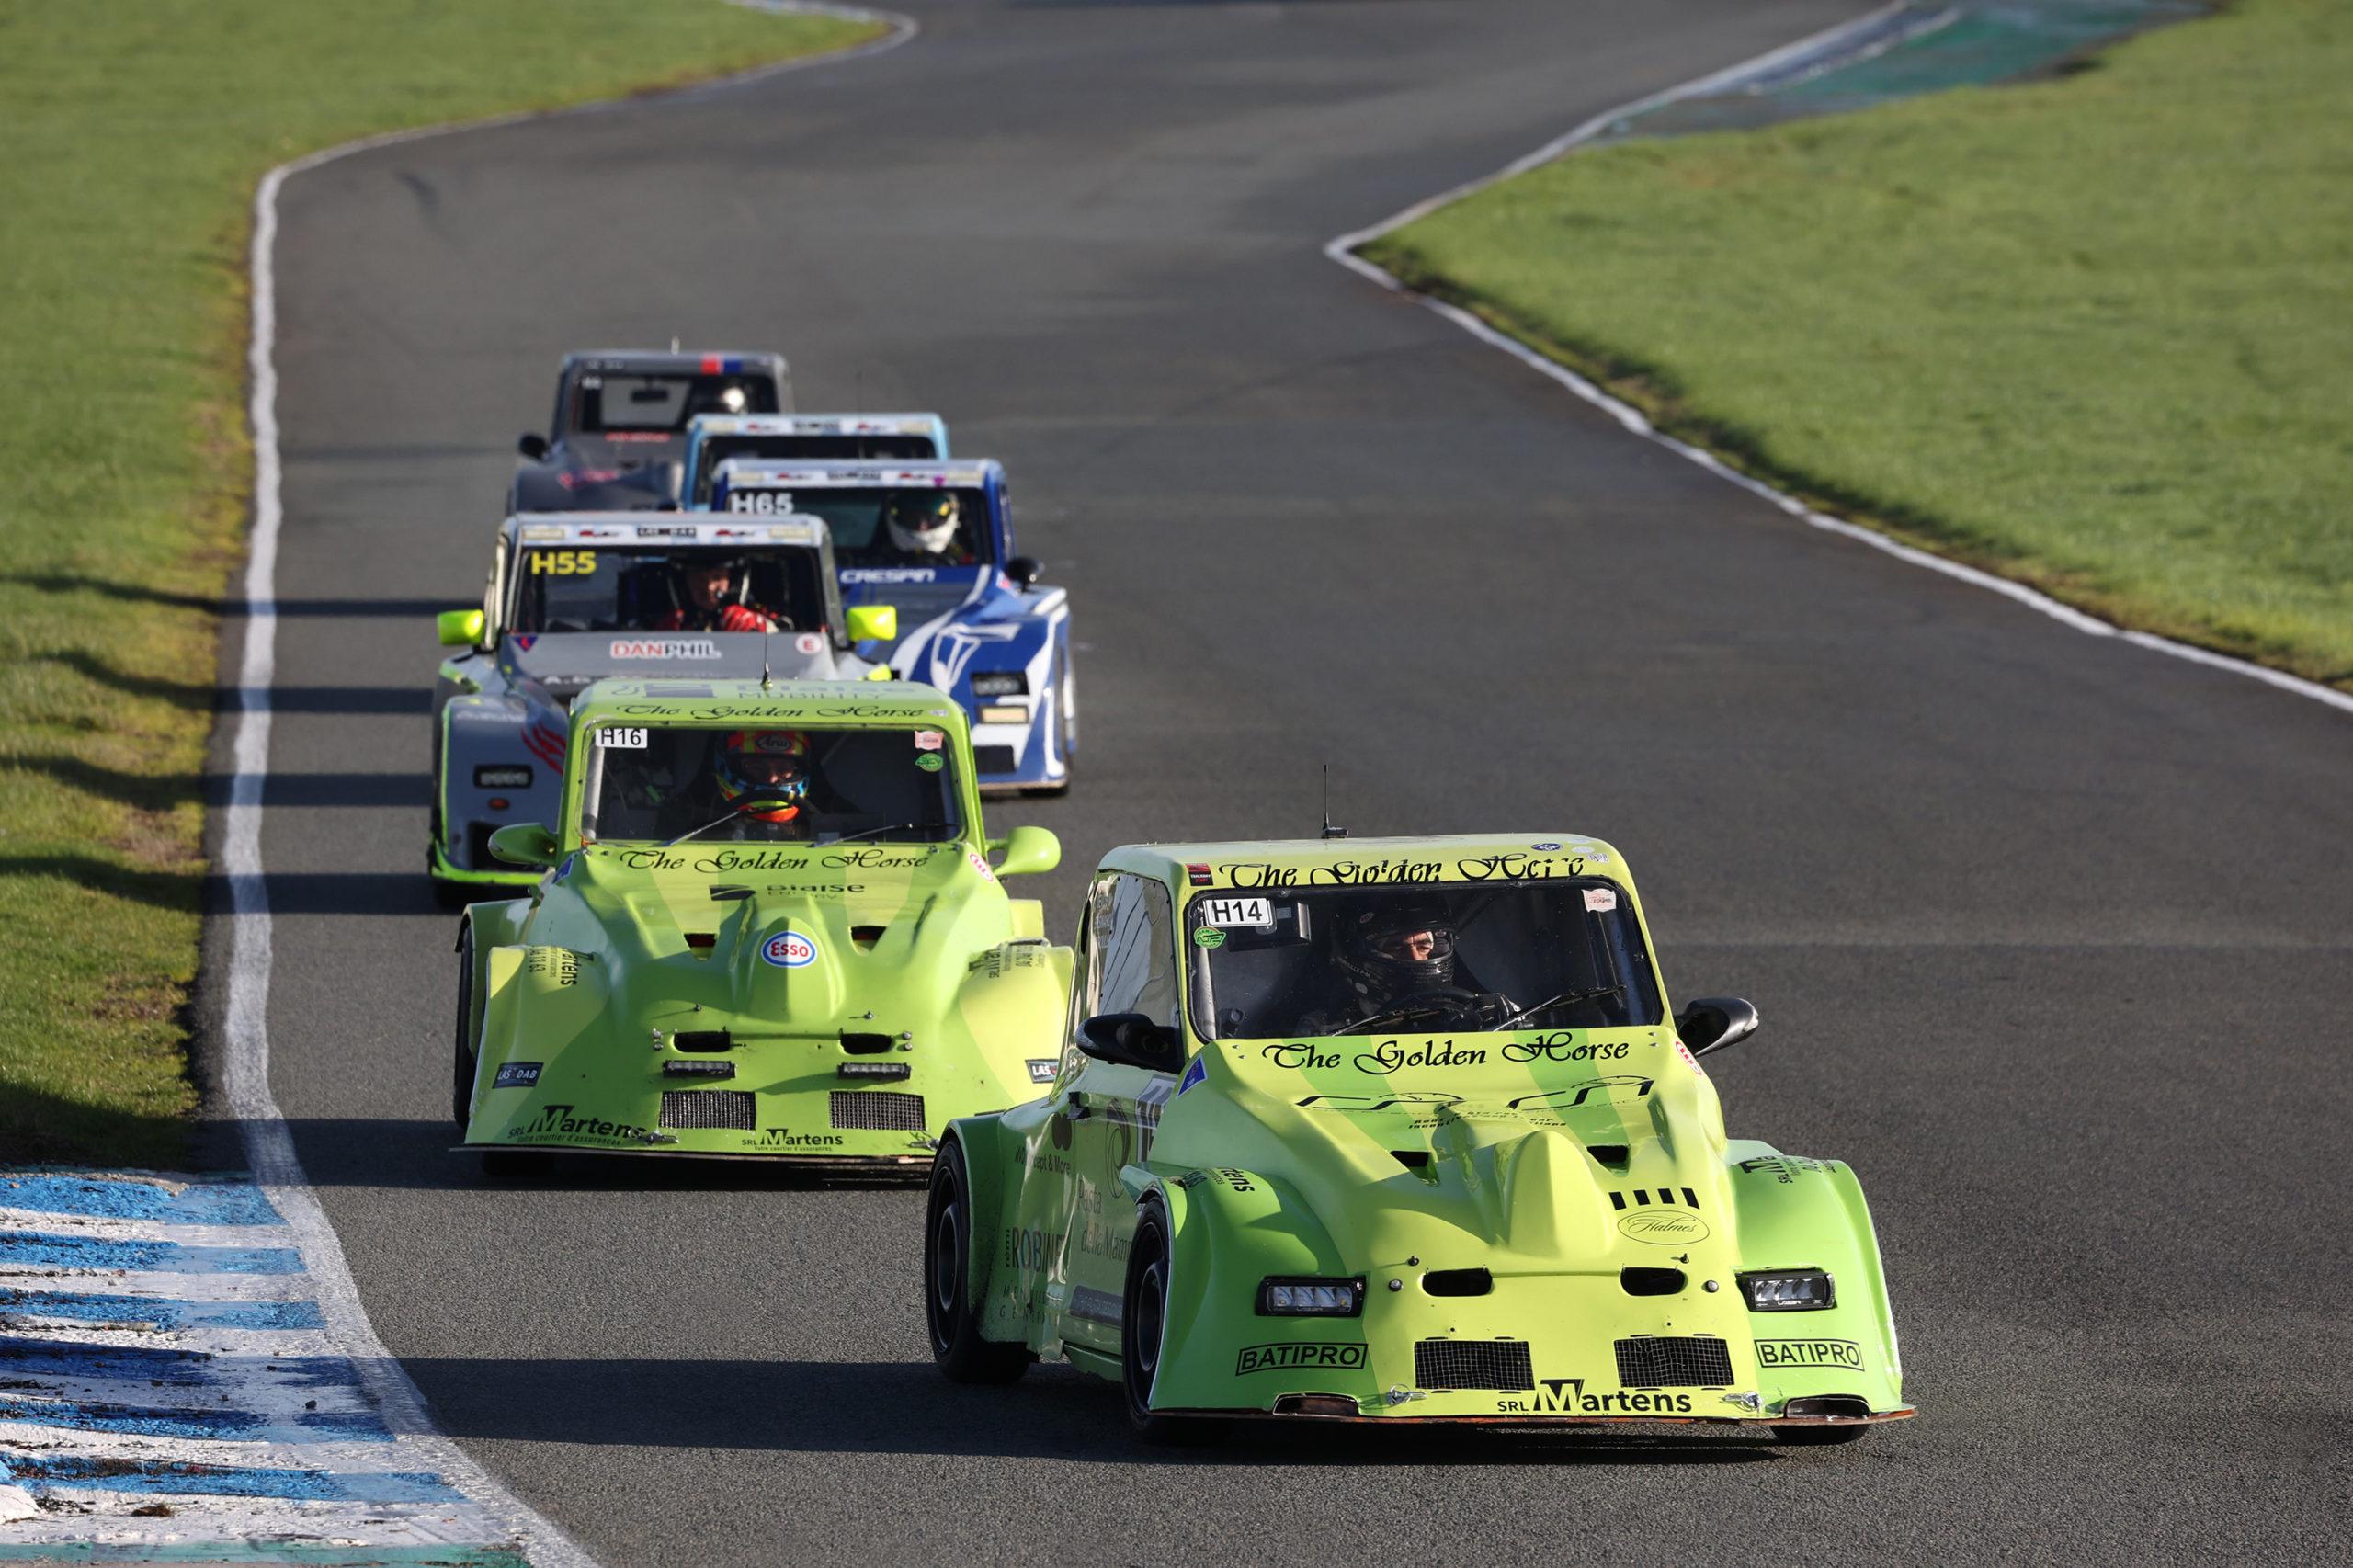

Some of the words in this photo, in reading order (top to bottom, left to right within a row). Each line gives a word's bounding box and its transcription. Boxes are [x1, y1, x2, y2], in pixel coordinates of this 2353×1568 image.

[731, 493, 794, 514] H65
[530, 551, 597, 574] H55
[610, 639, 722, 659] DANPHIL
[616, 704, 680, 716] The
[691, 705, 803, 720] Golden
[817, 705, 924, 717] Horse
[600, 728, 642, 745] H16
[620, 849, 685, 869] The
[694, 849, 809, 873] Golden
[821, 849, 929, 869] Horse
[1212, 900, 1263, 923] H14
[1261, 1043, 1340, 1069] The
[1353, 1040, 1486, 1075] Golden
[1501, 1031, 1629, 1062] Horse
[760, 1129, 843, 1145] Martens
[1241, 1346, 1360, 1370] BATIPRO
[1760, 1344, 1859, 1366] BATIPRO
[1497, 1401, 1529, 1412] SRL
[1533, 1379, 1692, 1413] Martens
